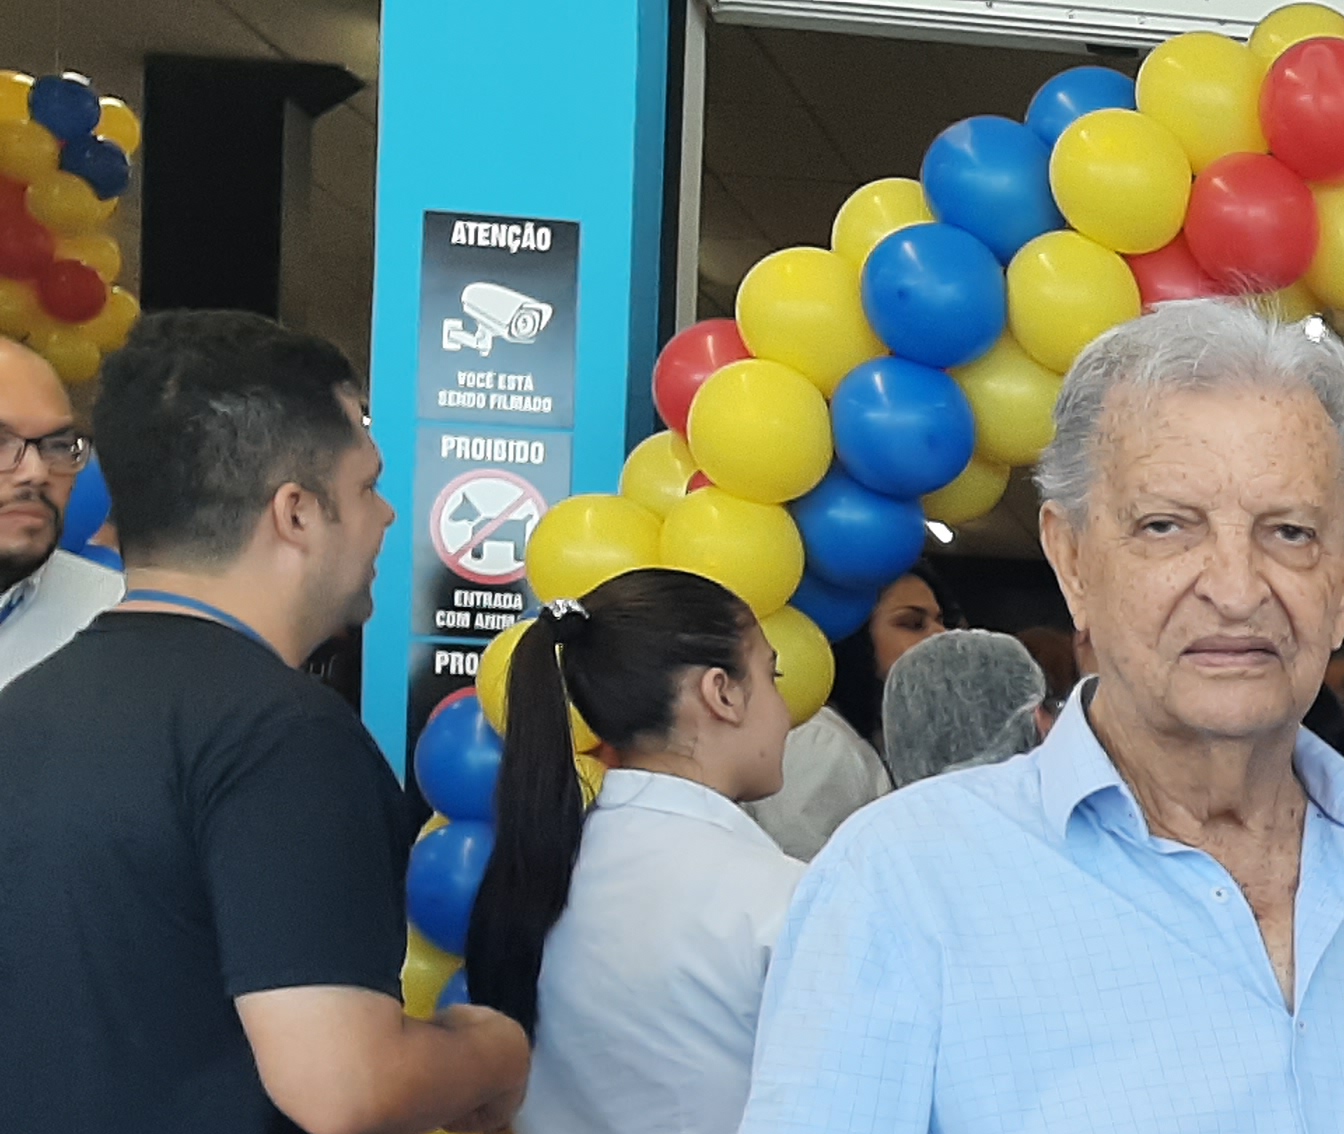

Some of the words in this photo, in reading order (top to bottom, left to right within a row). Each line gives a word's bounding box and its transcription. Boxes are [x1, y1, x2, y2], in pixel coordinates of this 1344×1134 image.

[450, 220, 552, 253] ATENÇÃO
[457, 370, 496, 389] VOCÊ
[497, 372, 534, 391] ESTÁ
[440, 435, 545, 464] PROIBIDO
[454, 589, 523, 611] ENTRADA
[435, 609, 471, 629] COM
[474, 612, 520, 630] ANIM
